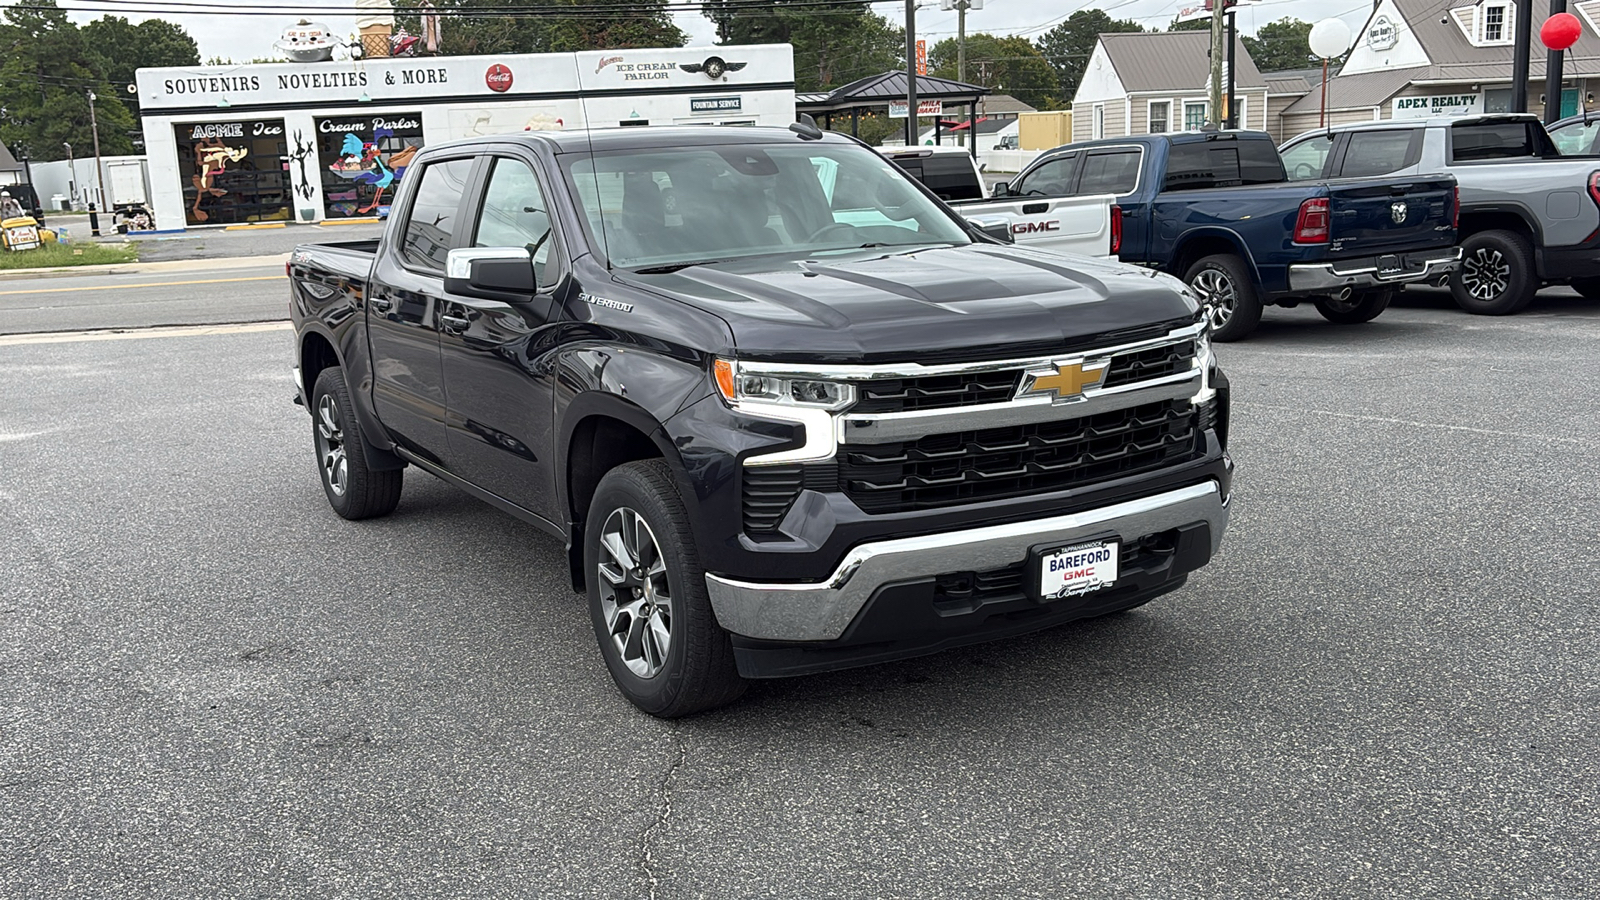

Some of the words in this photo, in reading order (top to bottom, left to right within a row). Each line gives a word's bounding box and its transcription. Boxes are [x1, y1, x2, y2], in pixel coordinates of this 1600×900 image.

[918, 41, 926, 73] ACME
[616, 64, 634, 72] ICE
[636, 62, 677, 71] CREAM
[164, 75, 260, 95] SOUVENIRS
[277, 71, 368, 90] NOVELTIES
[385, 70, 396, 86] &
[402, 68, 448, 85] MORE
[624, 71, 669, 81] PARLOR
[692, 101, 718, 110] FOUNTAIN
[718, 99, 740, 108] SERVICE
[1397, 98, 1428, 109] APEX
[1431, 95, 1477, 107] REALTY
[192, 123, 244, 139] ACME
[252, 122, 283, 136] Ice
[319, 119, 367, 133] Cream
[371, 117, 420, 131] Parlor
[1012, 219, 1060, 234] GMC
[578, 292, 634, 313] SILVERADO
[1061, 541, 1103, 553] TAPPAHANNOCK
[1050, 549, 1110, 572] BAREFORD
[1064, 567, 1095, 580] GMC
[1057, 579, 1103, 598] Bareford
